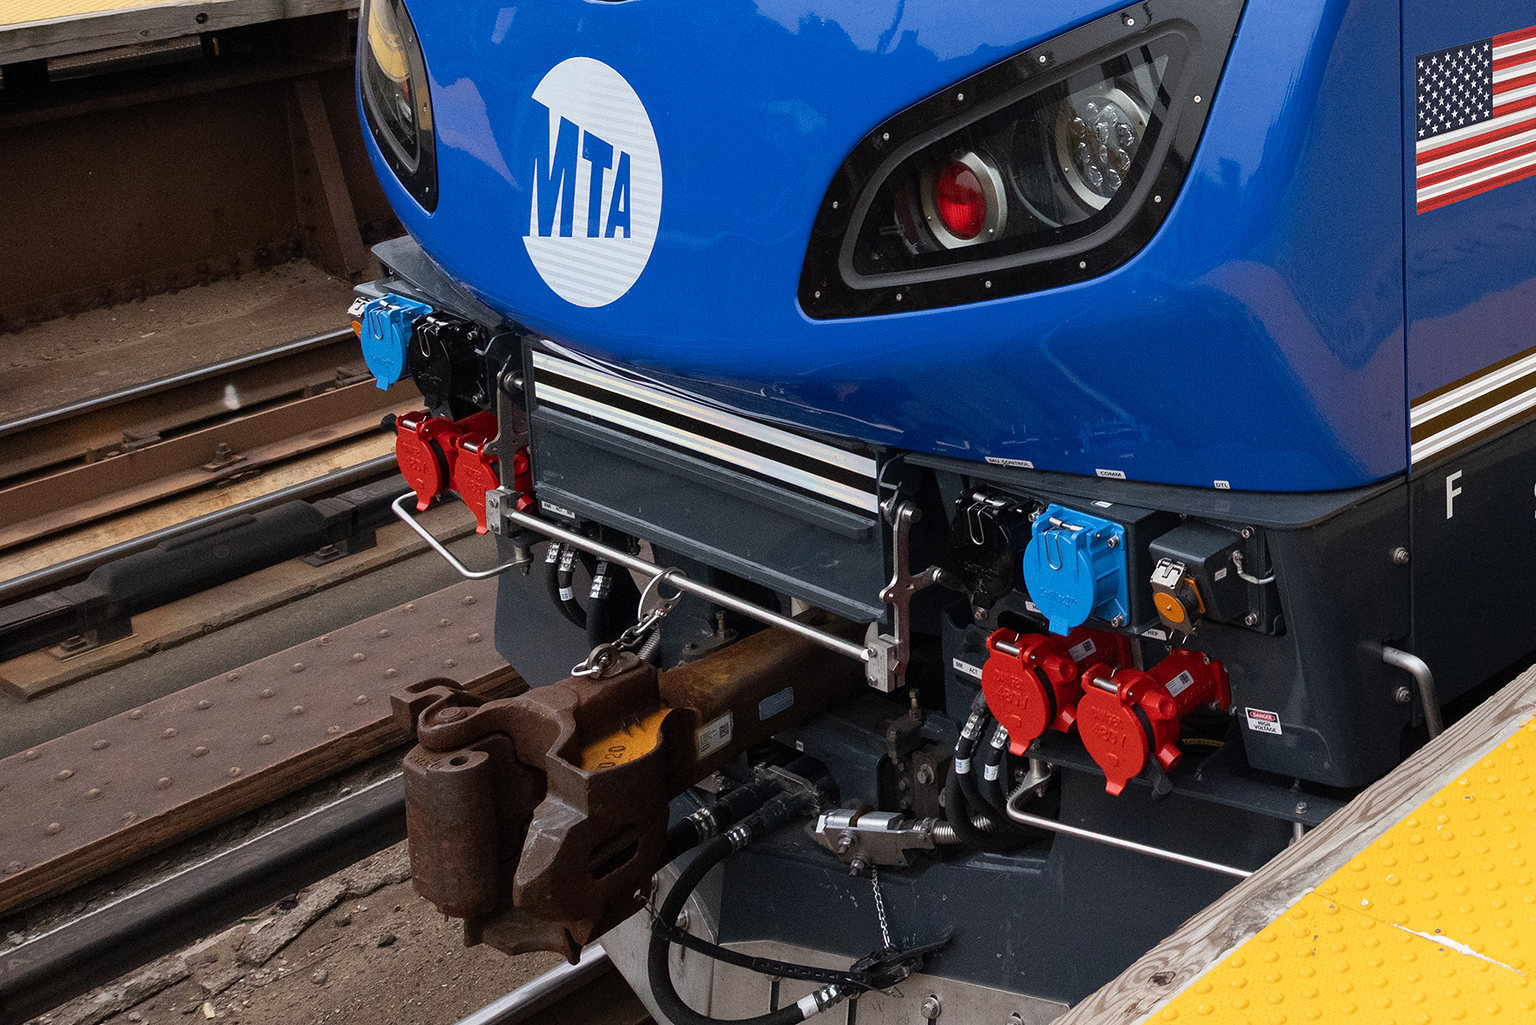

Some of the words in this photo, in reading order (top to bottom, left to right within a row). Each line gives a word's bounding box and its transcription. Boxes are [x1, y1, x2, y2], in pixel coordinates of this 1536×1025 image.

[524, 98, 632, 239] MTA
[1099, 470, 1122, 478] COMM
[1446, 469, 1463, 520] F
